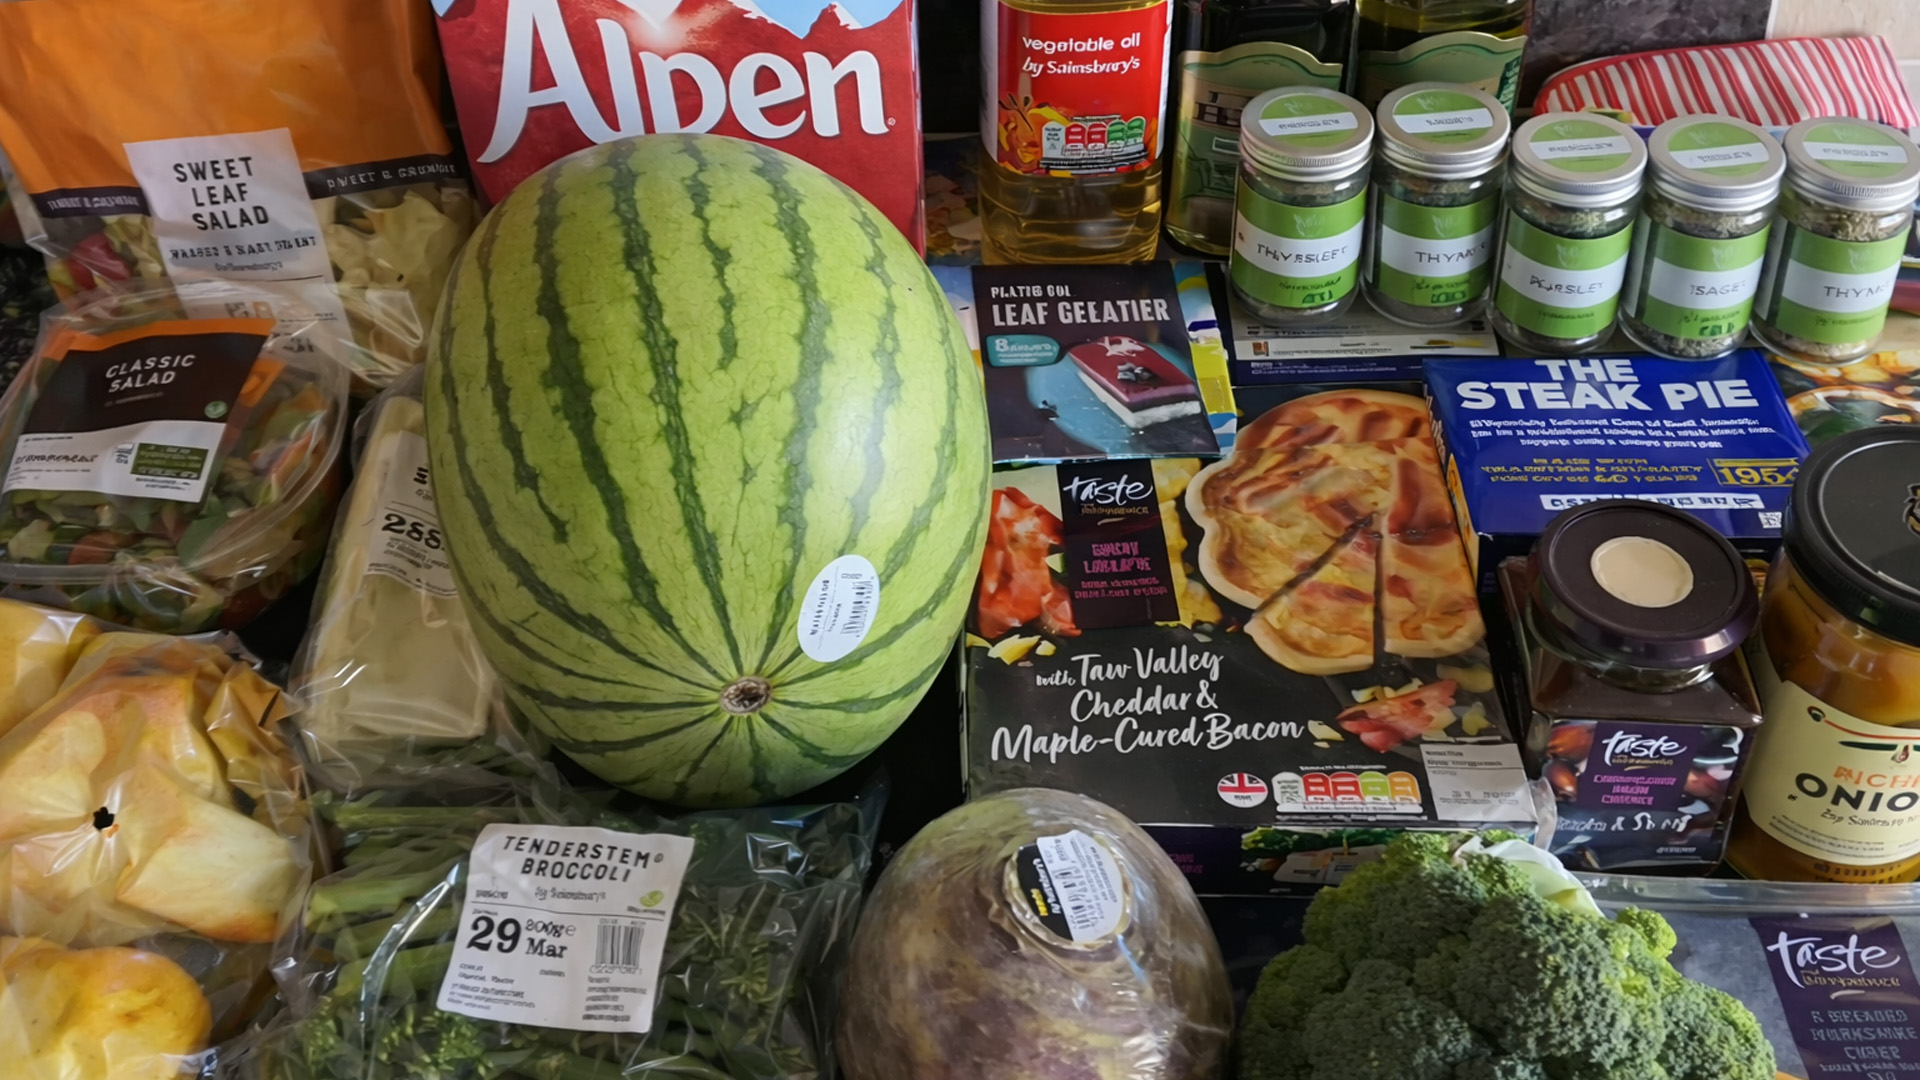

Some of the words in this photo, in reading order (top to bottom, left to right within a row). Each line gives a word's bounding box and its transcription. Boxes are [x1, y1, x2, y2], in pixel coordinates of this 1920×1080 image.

[1022, 56, 1044, 77] by
[476, 0, 890, 163] Alpen
[173, 157, 253, 182] SWEET
[191, 183, 248, 207] LEAF
[192, 205, 270, 231] SALAD
[992, 302, 1049, 326] LEAF
[105, 354, 196, 379] CLASSIC
[1535, 359, 1639, 382] THE
[108, 371, 176, 393] SALAD
[1456, 381, 1653, 411] STEAK
[1659, 379, 1760, 411] PIE
[1071, 653, 1133, 686] Taw
[1133, 644, 1224, 681] Valley
[1071, 685, 1192, 722] Cheddar
[1196, 680, 1219, 710] &
[991, 716, 1204, 764] Maple-Cured
[1203, 713, 1305, 750] Bacon
[503, 836, 651, 868] TENDERSTEM
[521, 858, 632, 882] BROCCOLI
[466, 915, 523, 953] 29
[525, 937, 568, 958] Mar
